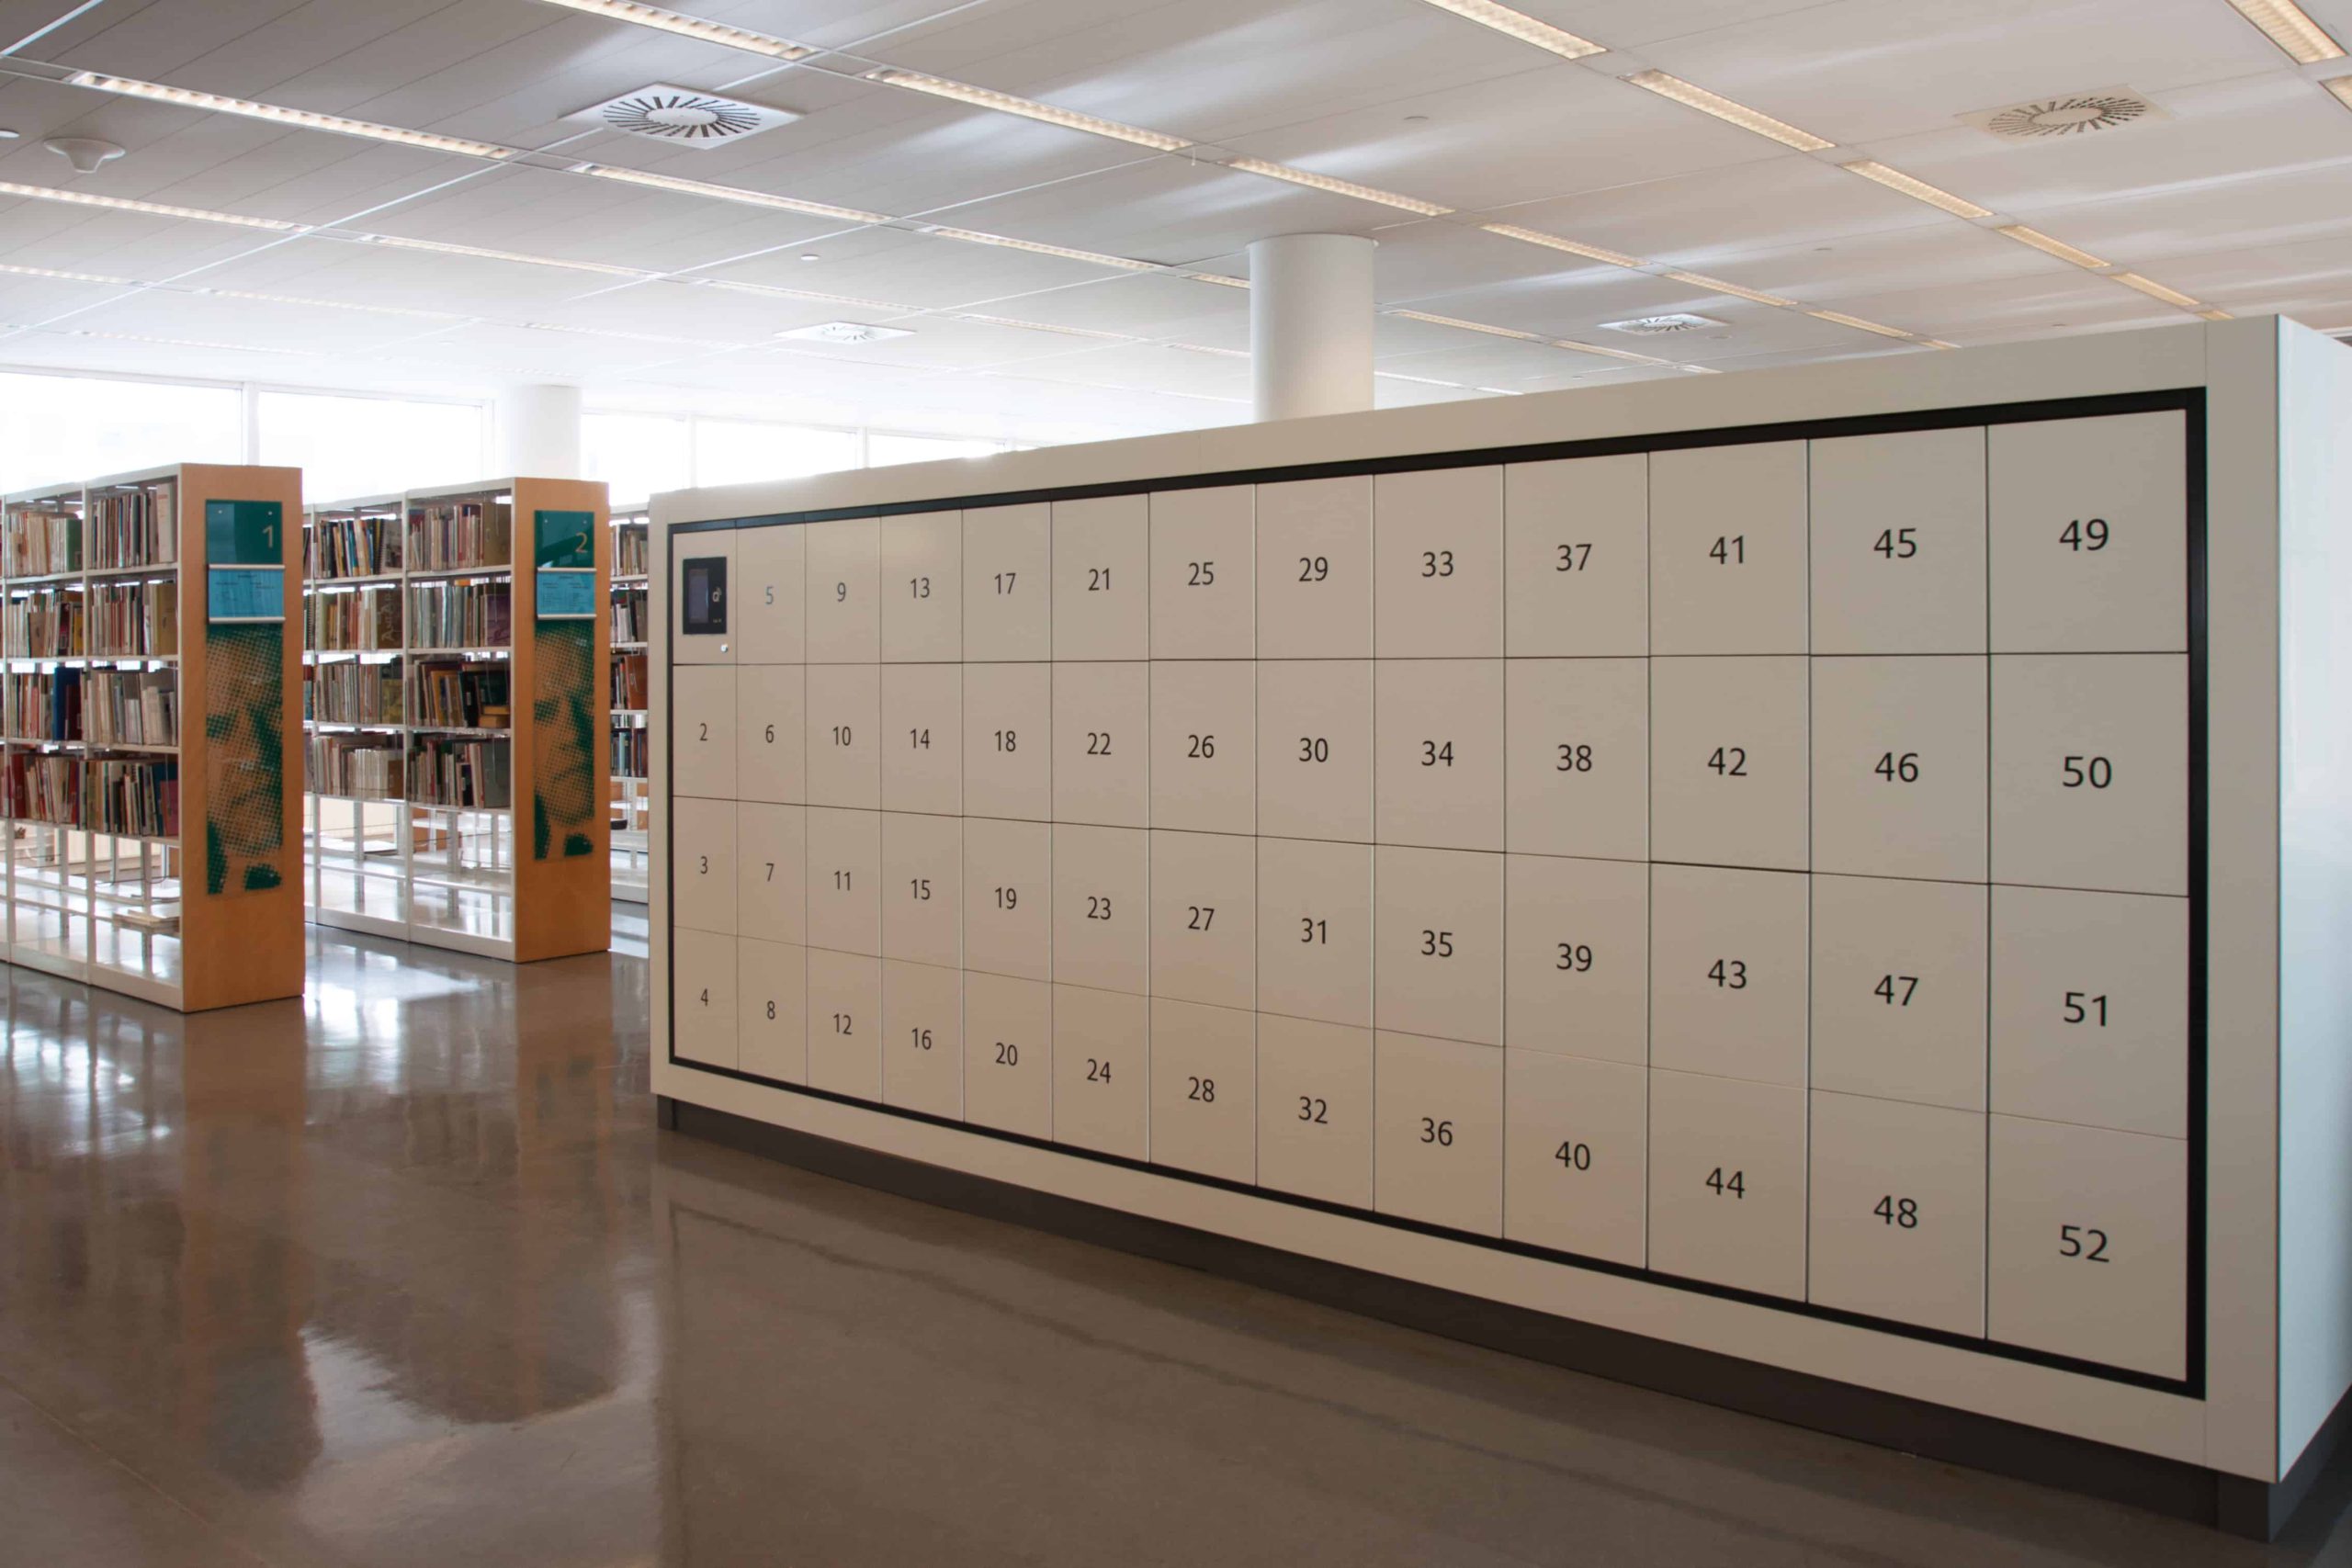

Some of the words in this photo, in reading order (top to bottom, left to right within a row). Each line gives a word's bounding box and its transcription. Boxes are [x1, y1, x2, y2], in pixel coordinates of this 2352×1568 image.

[262, 525, 274, 548] 1
[575, 532, 588, 553] 2
[1873, 527, 1917, 559] 45
[2059, 518, 2109, 552] 49
[1556, 543, 1592, 572] 37
[1709, 535, 1744, 565] 41
[1188, 561, 1215, 586] 25
[1298, 556, 1329, 582] 29
[1421, 550, 1454, 578] 33
[836, 581, 847, 603] 9
[910, 577, 931, 599] 13
[994, 572, 1016, 594] 17
[1088, 568, 1110, 592] 21
[765, 585, 775, 605] 5
[699, 722, 708, 742] 2
[765, 724, 775, 744] 6
[832, 726, 852, 747] 10
[910, 728, 930, 750] 14
[994, 730, 1016, 752] 18
[1087, 732, 1112, 756] 22
[1187, 734, 1215, 759] 26
[1298, 737, 1329, 763] 30
[1421, 740, 1454, 767] 34
[1556, 744, 1592, 773] 38
[1707, 747, 1747, 777] 42
[1874, 751, 1919, 783] 46
[2063, 756, 2112, 789] 50
[700, 855, 708, 874] 3
[765, 863, 775, 882] 7
[834, 870, 851, 891] 11
[910, 878, 931, 901] 15
[994, 886, 1017, 910] 19
[1087, 896, 1112, 920] 23
[1188, 906, 1215, 931] 27
[1301, 918, 1326, 944] 31
[1421, 930, 1453, 958] 35
[1556, 942, 1592, 973] 39
[1707, 959, 1747, 989] 43
[700, 988, 709, 1007] 4
[1873, 975, 1919, 1007] 47
[766, 999, 776, 1021] 8
[2064, 991, 2107, 1027] 51
[833, 1013, 853, 1035] 12
[911, 1027, 933, 1051] 16
[995, 1042, 1018, 1066] 20
[1087, 1058, 1112, 1084] 24
[1188, 1076, 1215, 1103] 28
[1298, 1096, 1329, 1124] 32
[1420, 1117, 1453, 1147] 36
[1555, 1141, 1591, 1171] 40
[1705, 1167, 1746, 1200] 44
[1873, 1195, 1917, 1229] 48
[2060, 1224, 2110, 1263] 52
